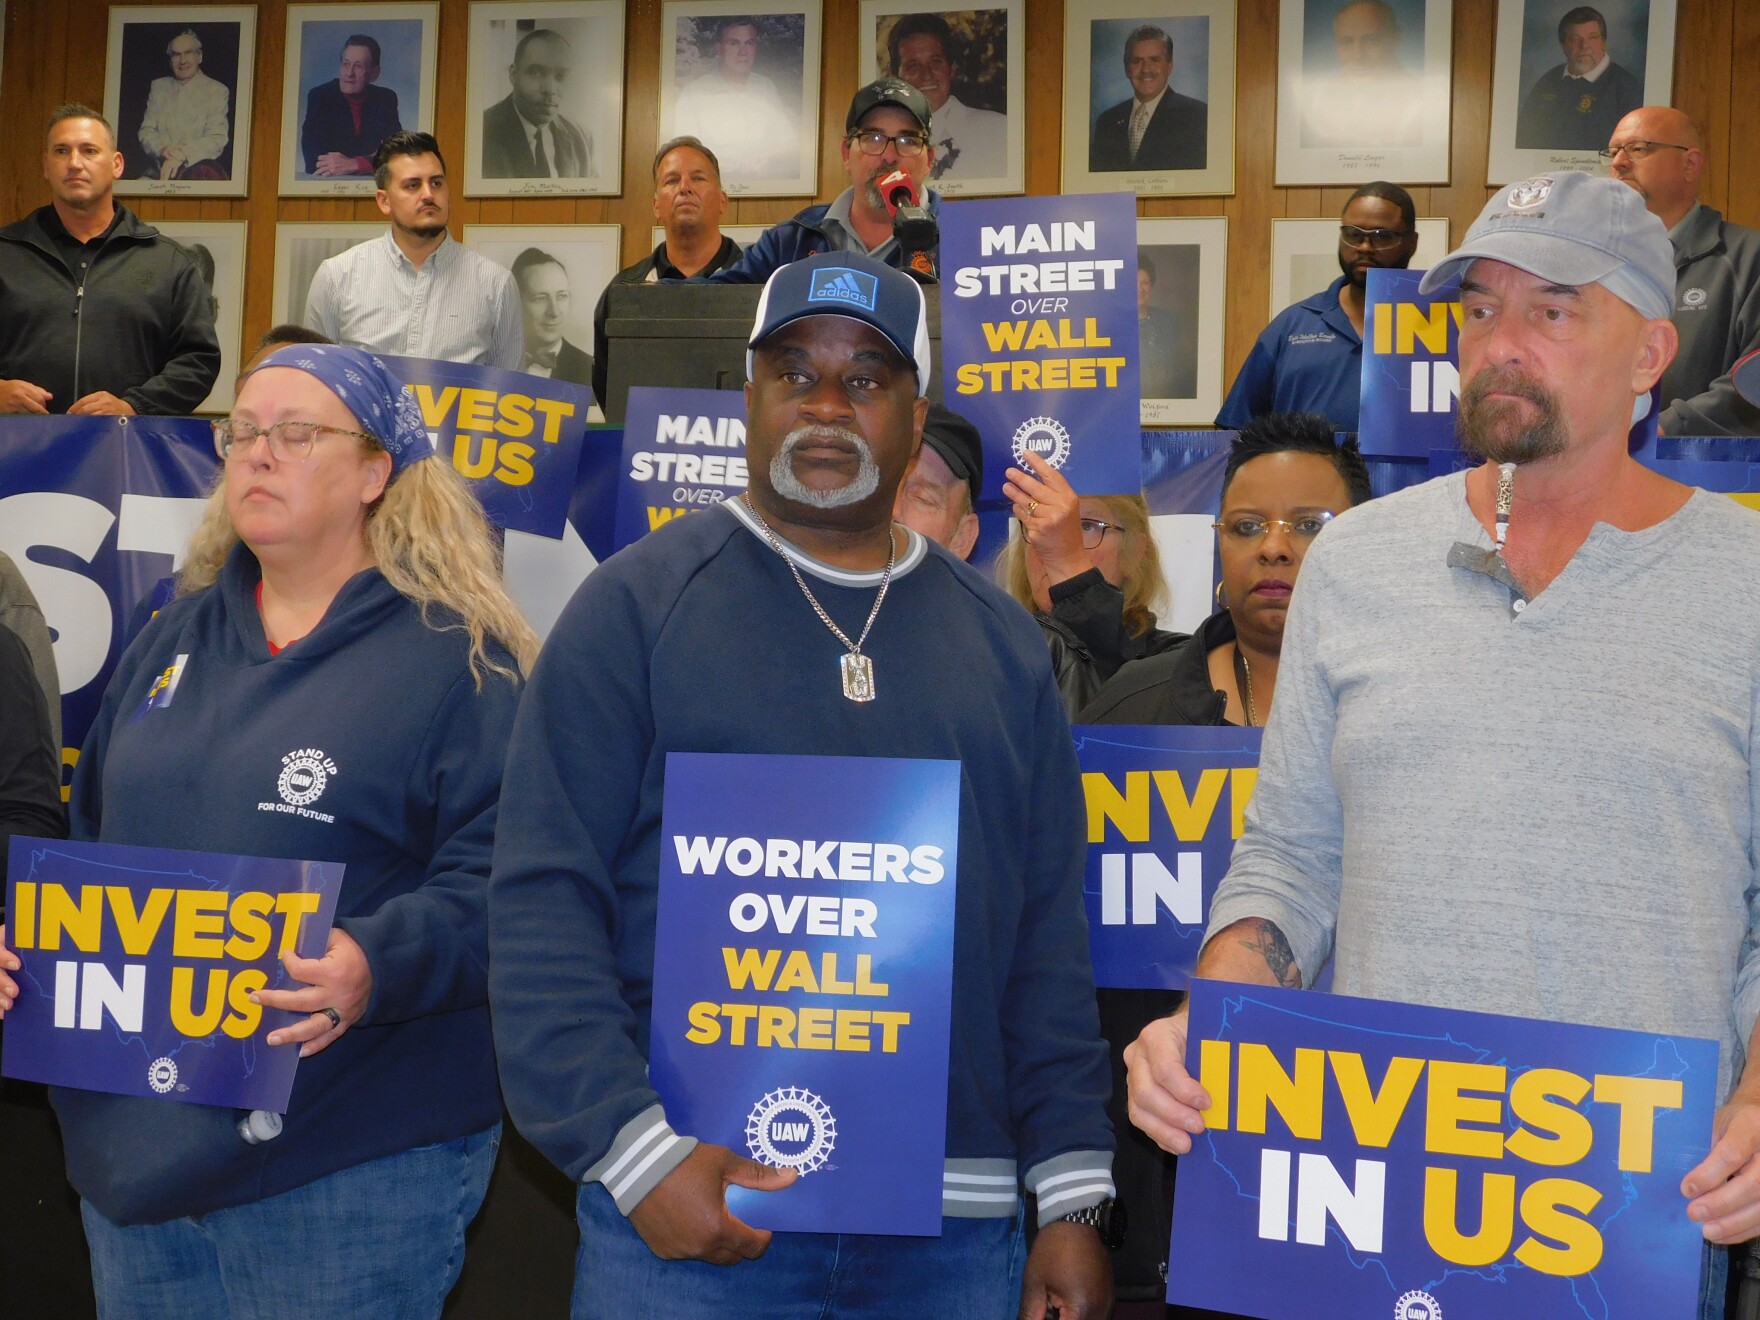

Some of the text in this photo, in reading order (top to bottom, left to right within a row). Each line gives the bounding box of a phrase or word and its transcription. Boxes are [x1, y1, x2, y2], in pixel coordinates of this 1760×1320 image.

[981, 221, 1096, 256] MAIN
[816, 286, 868, 304] adidas
[953, 259, 1124, 298] STREET
[1011, 297, 1069, 315] OVER
[981, 317, 1112, 352] WALL
[955, 357, 1126, 395] STREET
[453, 434, 536, 486] US
[1028, 438, 1053, 452] UAW
[672, 487, 725, 504] OVER
[281, 748, 338, 776] STAND UP
[290, 773, 314, 788] UAW
[257, 802, 335, 824] FOR OUR FUTURE
[673, 835, 945, 885] WORKERS
[1102, 852, 1203, 926] IN
[13, 881, 321, 962] INVEST
[729, 892, 878, 938] OVER
[721, 947, 889, 997] WALL
[53, 960, 267, 1040] IN US
[685, 1001, 911, 1054] STREET
[1200, 1039, 1684, 1173] INVEST
[771, 1122, 810, 1142] UAW
[1258, 1148, 1604, 1277] IN US
[1407, 1307, 1429, 1320] UAW
